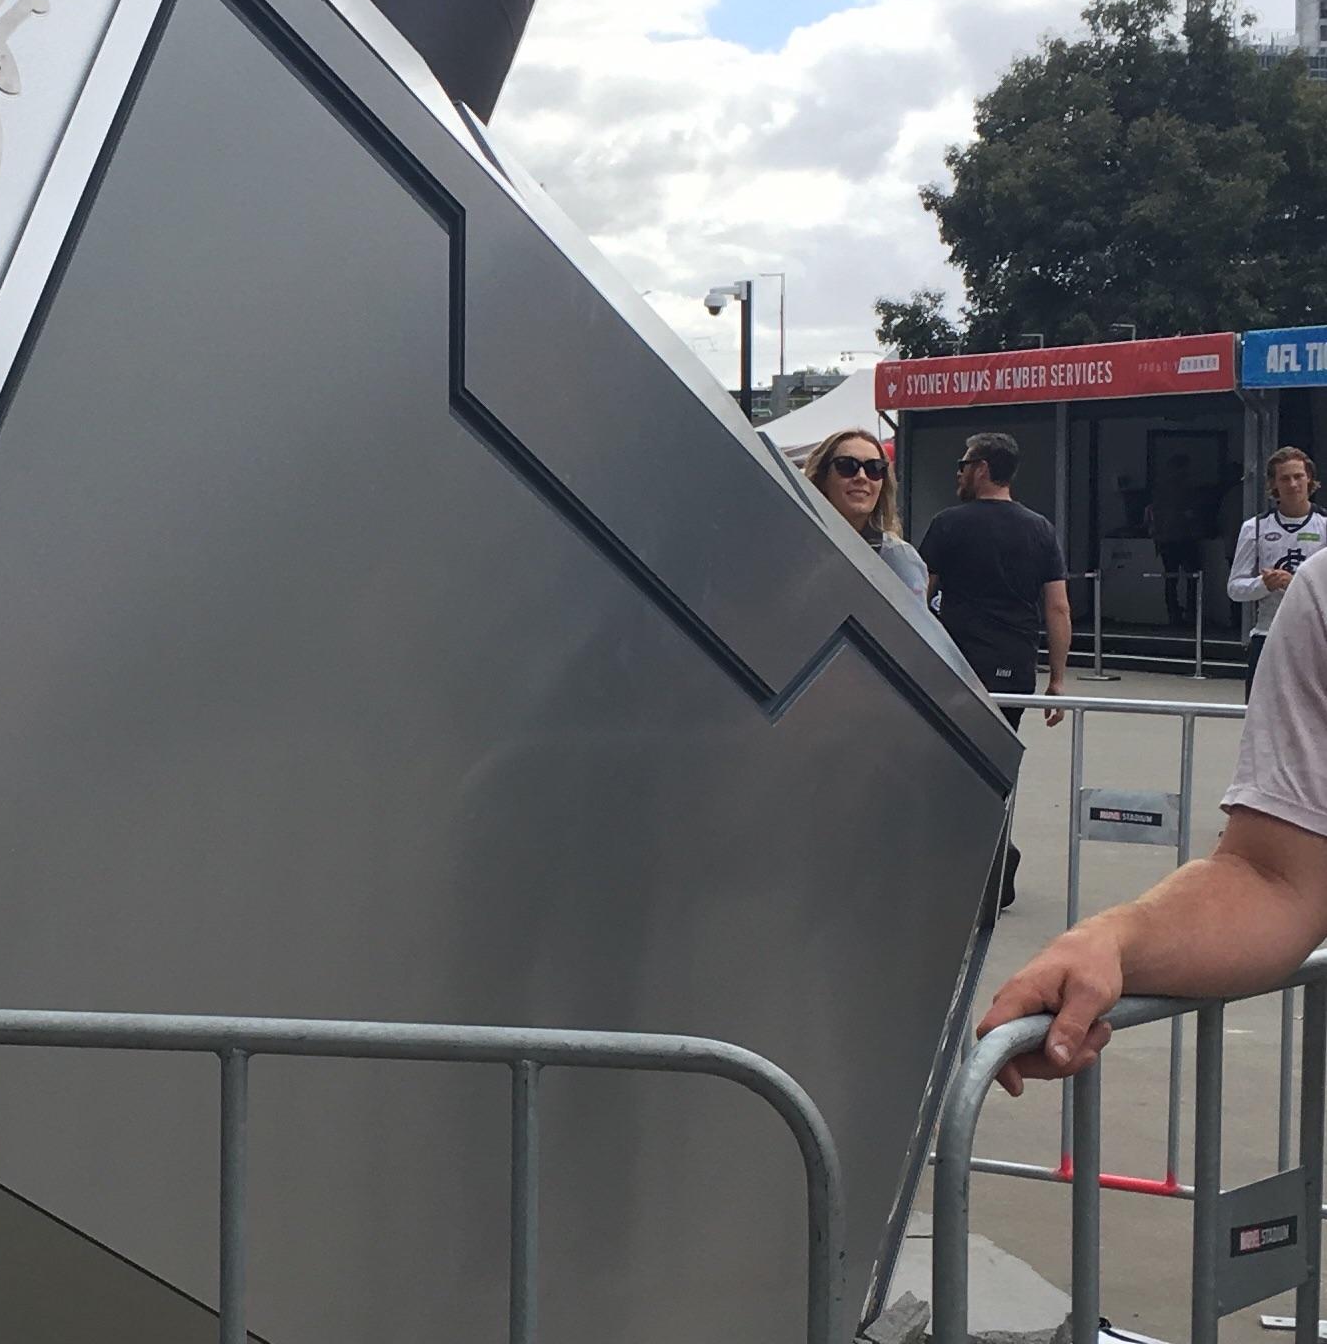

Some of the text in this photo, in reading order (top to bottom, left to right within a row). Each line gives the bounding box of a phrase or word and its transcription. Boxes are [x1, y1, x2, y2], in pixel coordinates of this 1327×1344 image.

[1267, 344, 1301, 373] AFL
[906, 360, 1113, 396] SYDNEY SWANS MEMBER SERVICES
